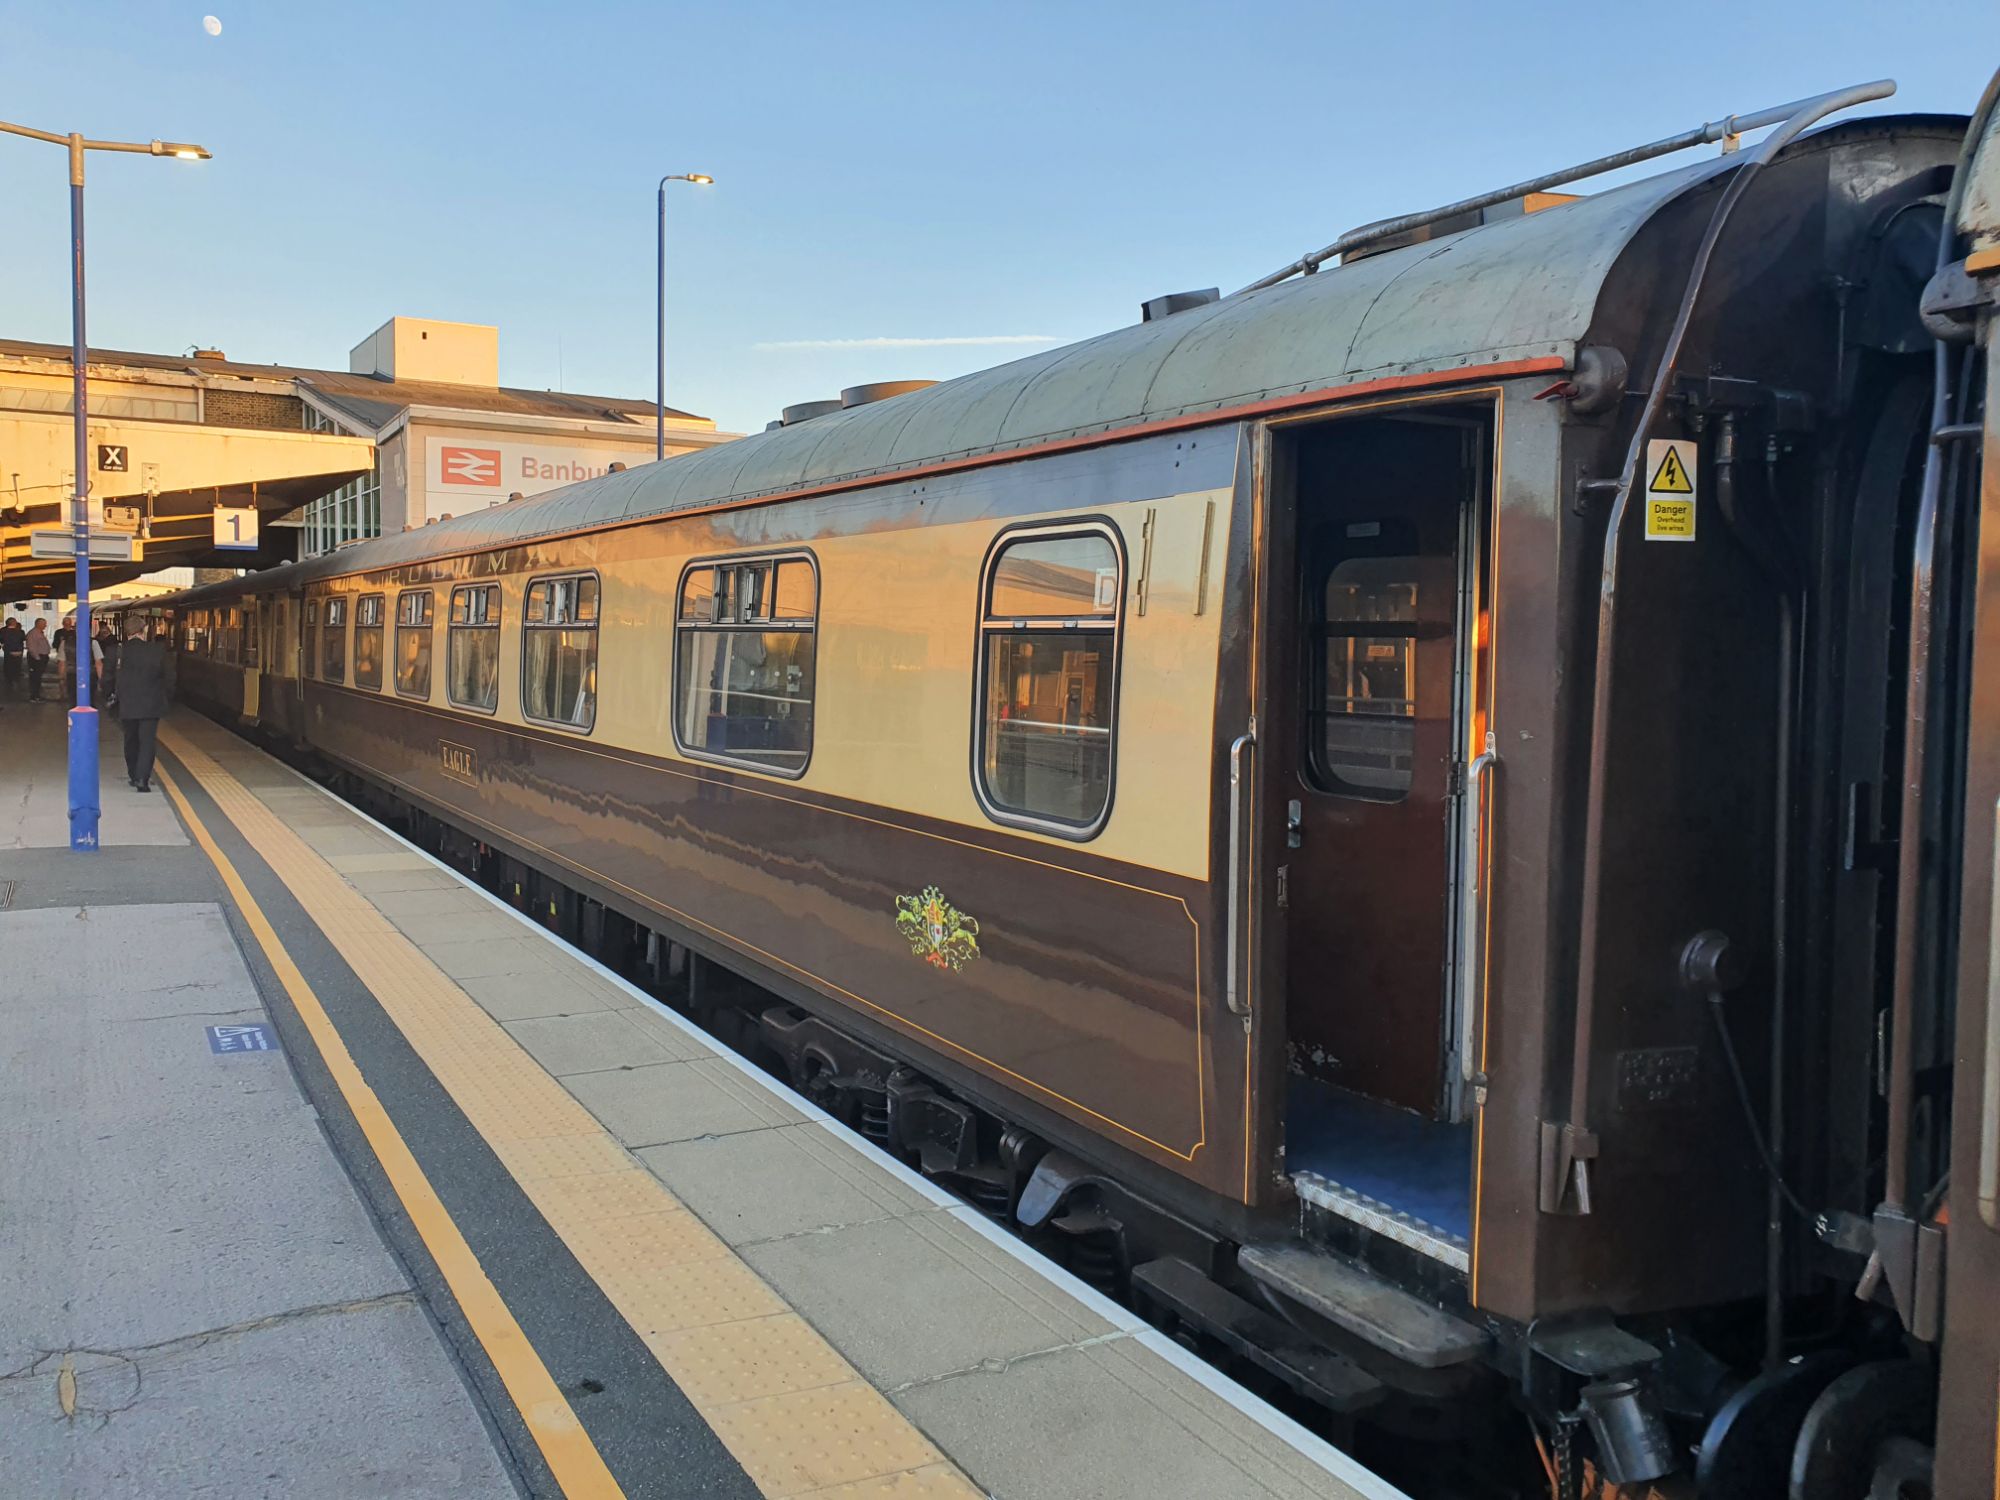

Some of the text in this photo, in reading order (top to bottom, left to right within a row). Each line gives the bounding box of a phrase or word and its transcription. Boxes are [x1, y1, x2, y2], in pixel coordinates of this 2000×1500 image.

[105, 447, 122, 465] X
[1654, 504, 1687, 516] Danger
[227, 514, 240, 542] 1
[1656, 516, 1685, 524] Overhead
[442, 746, 472, 777] EAGLE
